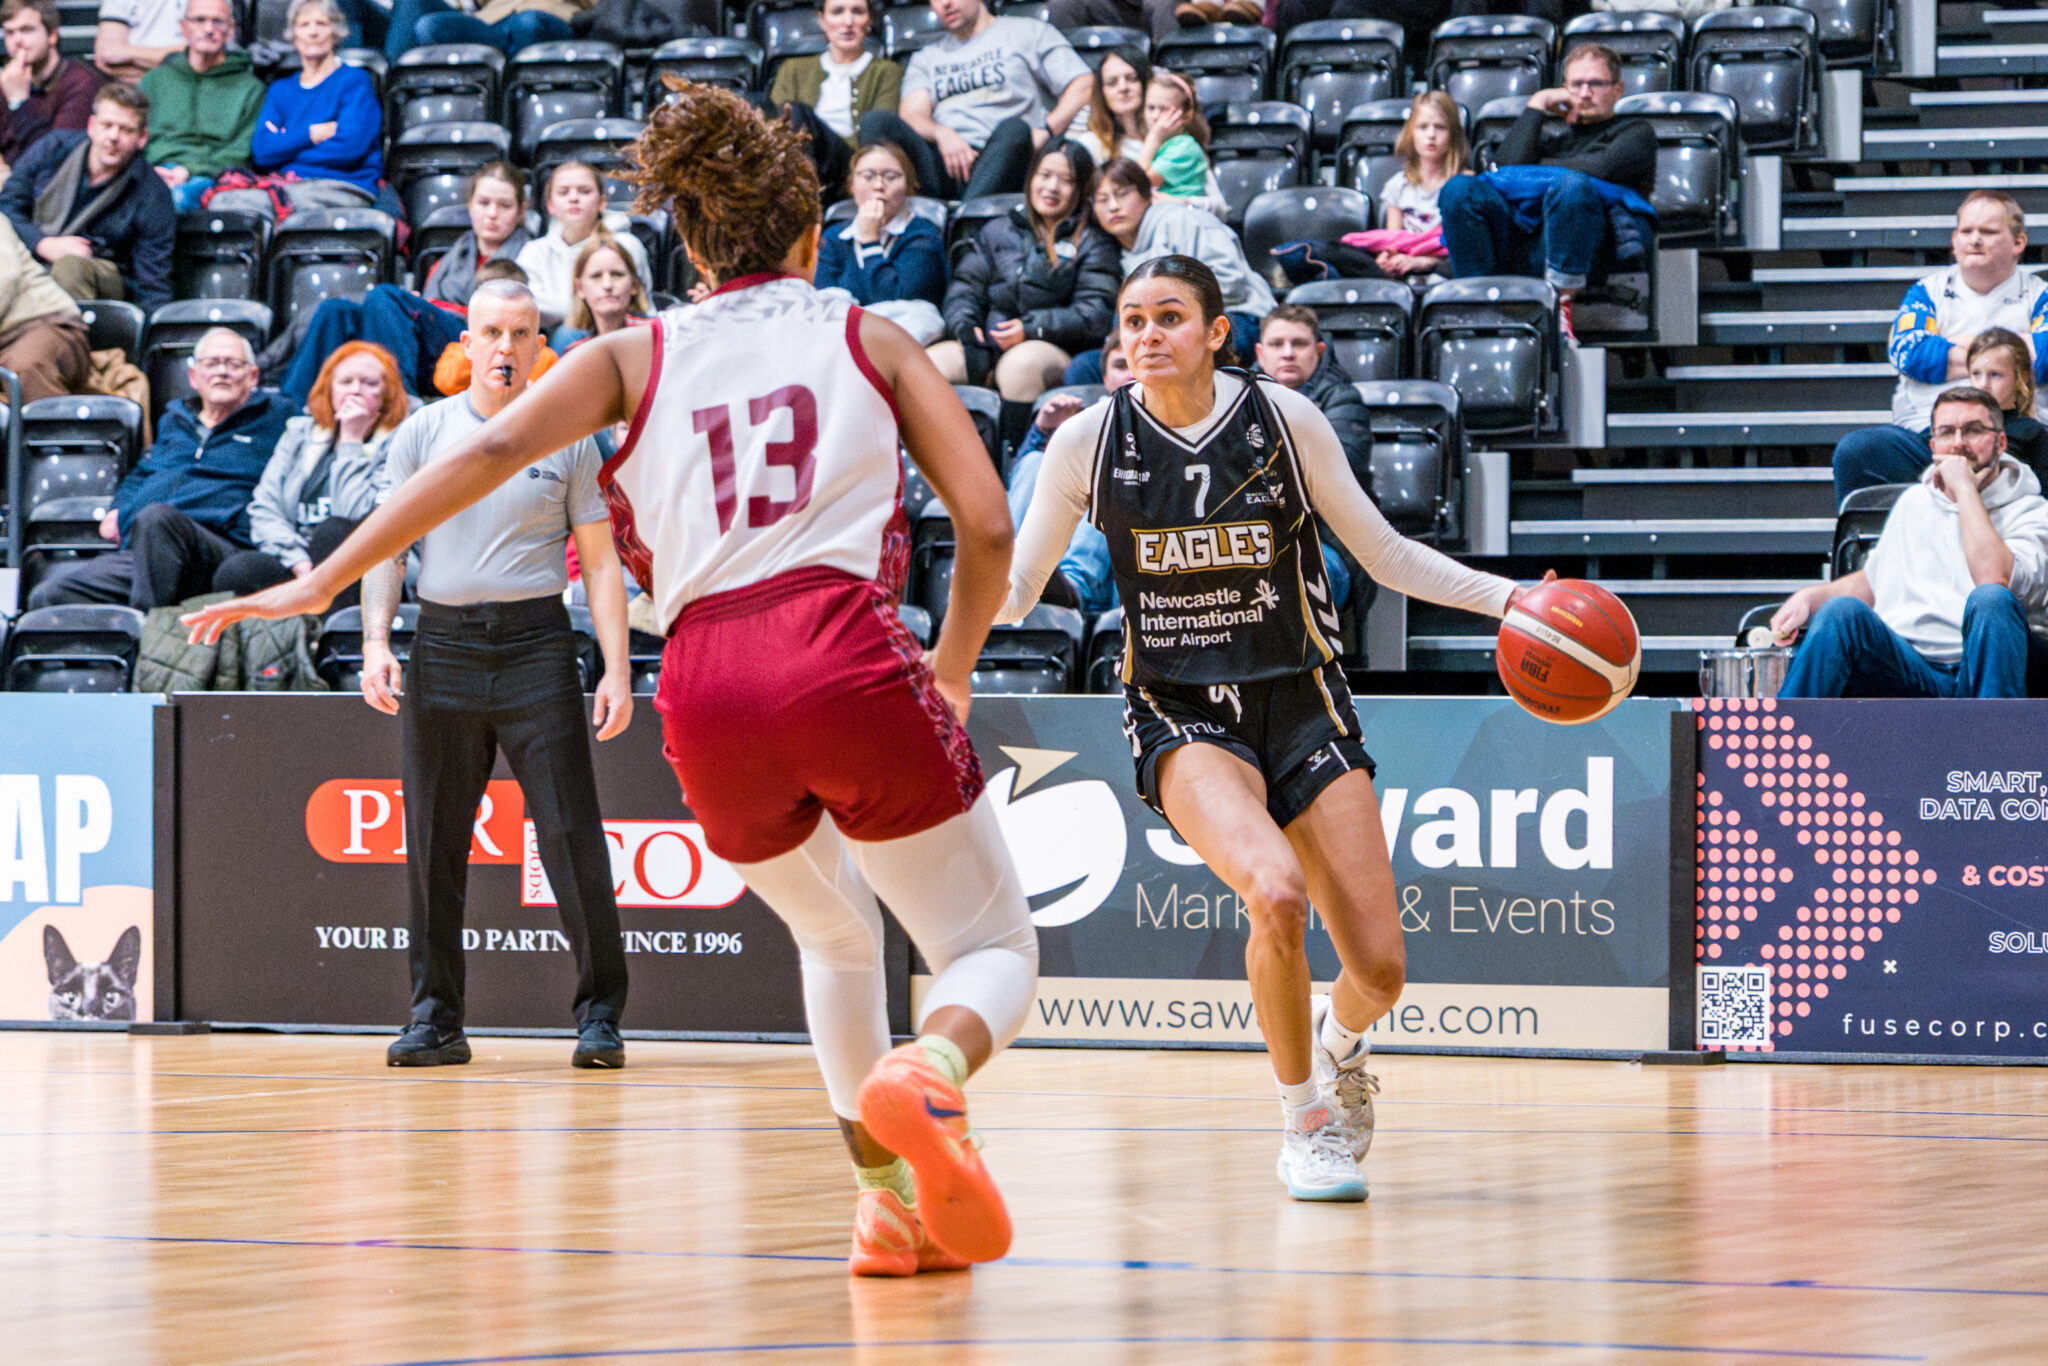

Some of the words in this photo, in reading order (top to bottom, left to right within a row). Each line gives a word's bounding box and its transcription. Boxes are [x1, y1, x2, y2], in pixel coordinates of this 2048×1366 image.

[934, 62, 1006, 102] EAGLES
[692, 384, 818, 538] 13
[1185, 464, 1211, 518] 7
[1137, 523, 1272, 573] EAGLES
[1139, 587, 1241, 610] Newcastle
[1140, 605, 1263, 632] International
[1142, 634, 1176, 648] Your
[1180, 630, 1232, 648] Airport
[1947, 770, 2048, 797] SMART,
[1920, 798, 1996, 821] DATA
[1962, 864, 1981, 887] &
[1399, 885, 1431, 933] &
[1450, 887, 1615, 935] Events
[315, 926, 388, 949] YOUR
[620, 931, 688, 954] INCE
[693, 932, 743, 954] 1996
